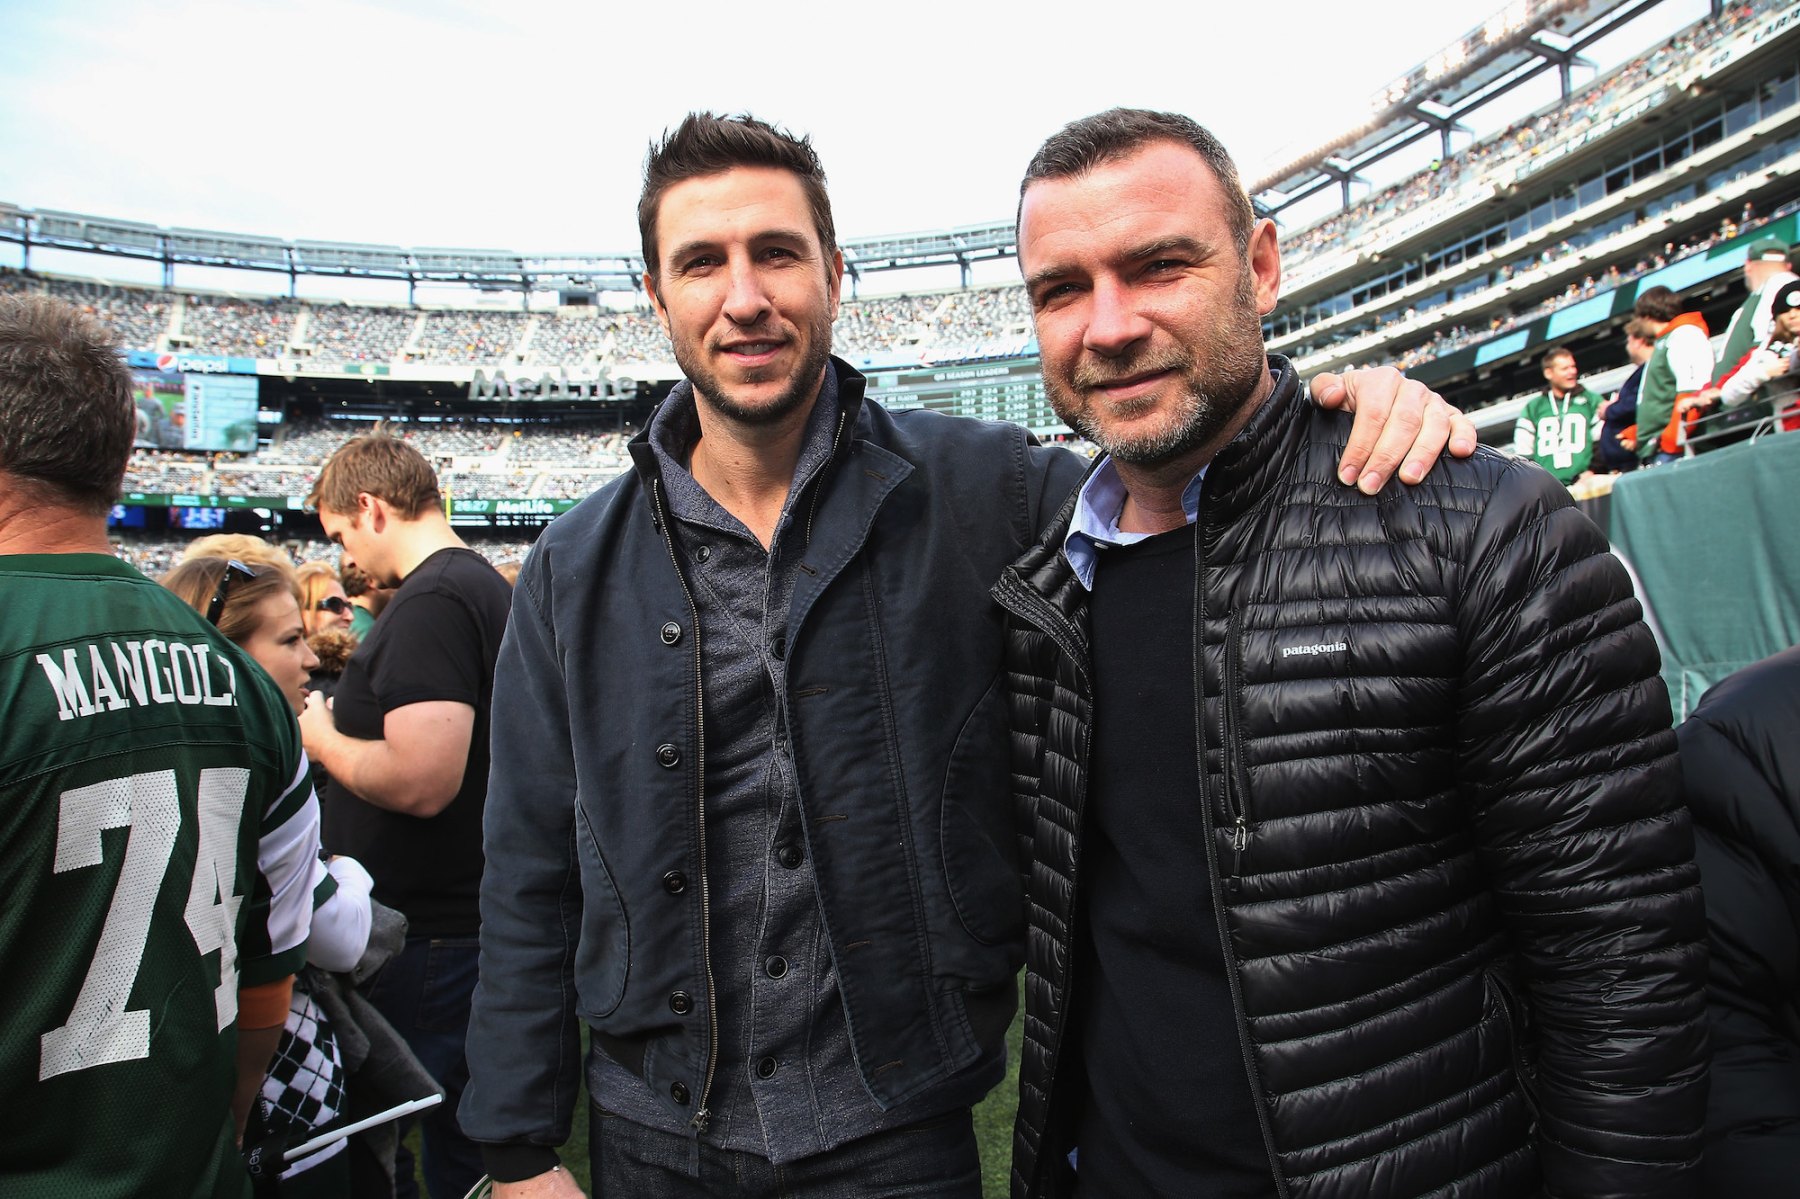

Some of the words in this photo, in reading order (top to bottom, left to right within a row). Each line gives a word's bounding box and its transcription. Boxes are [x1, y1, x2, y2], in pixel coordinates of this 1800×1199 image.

[178, 358, 228, 374] pepsi
[468, 366, 638, 401] MetLife
[1537, 413, 1587, 457] 80
[1282, 641, 1347, 658] patagonia
[39, 767, 251, 1082] 74
